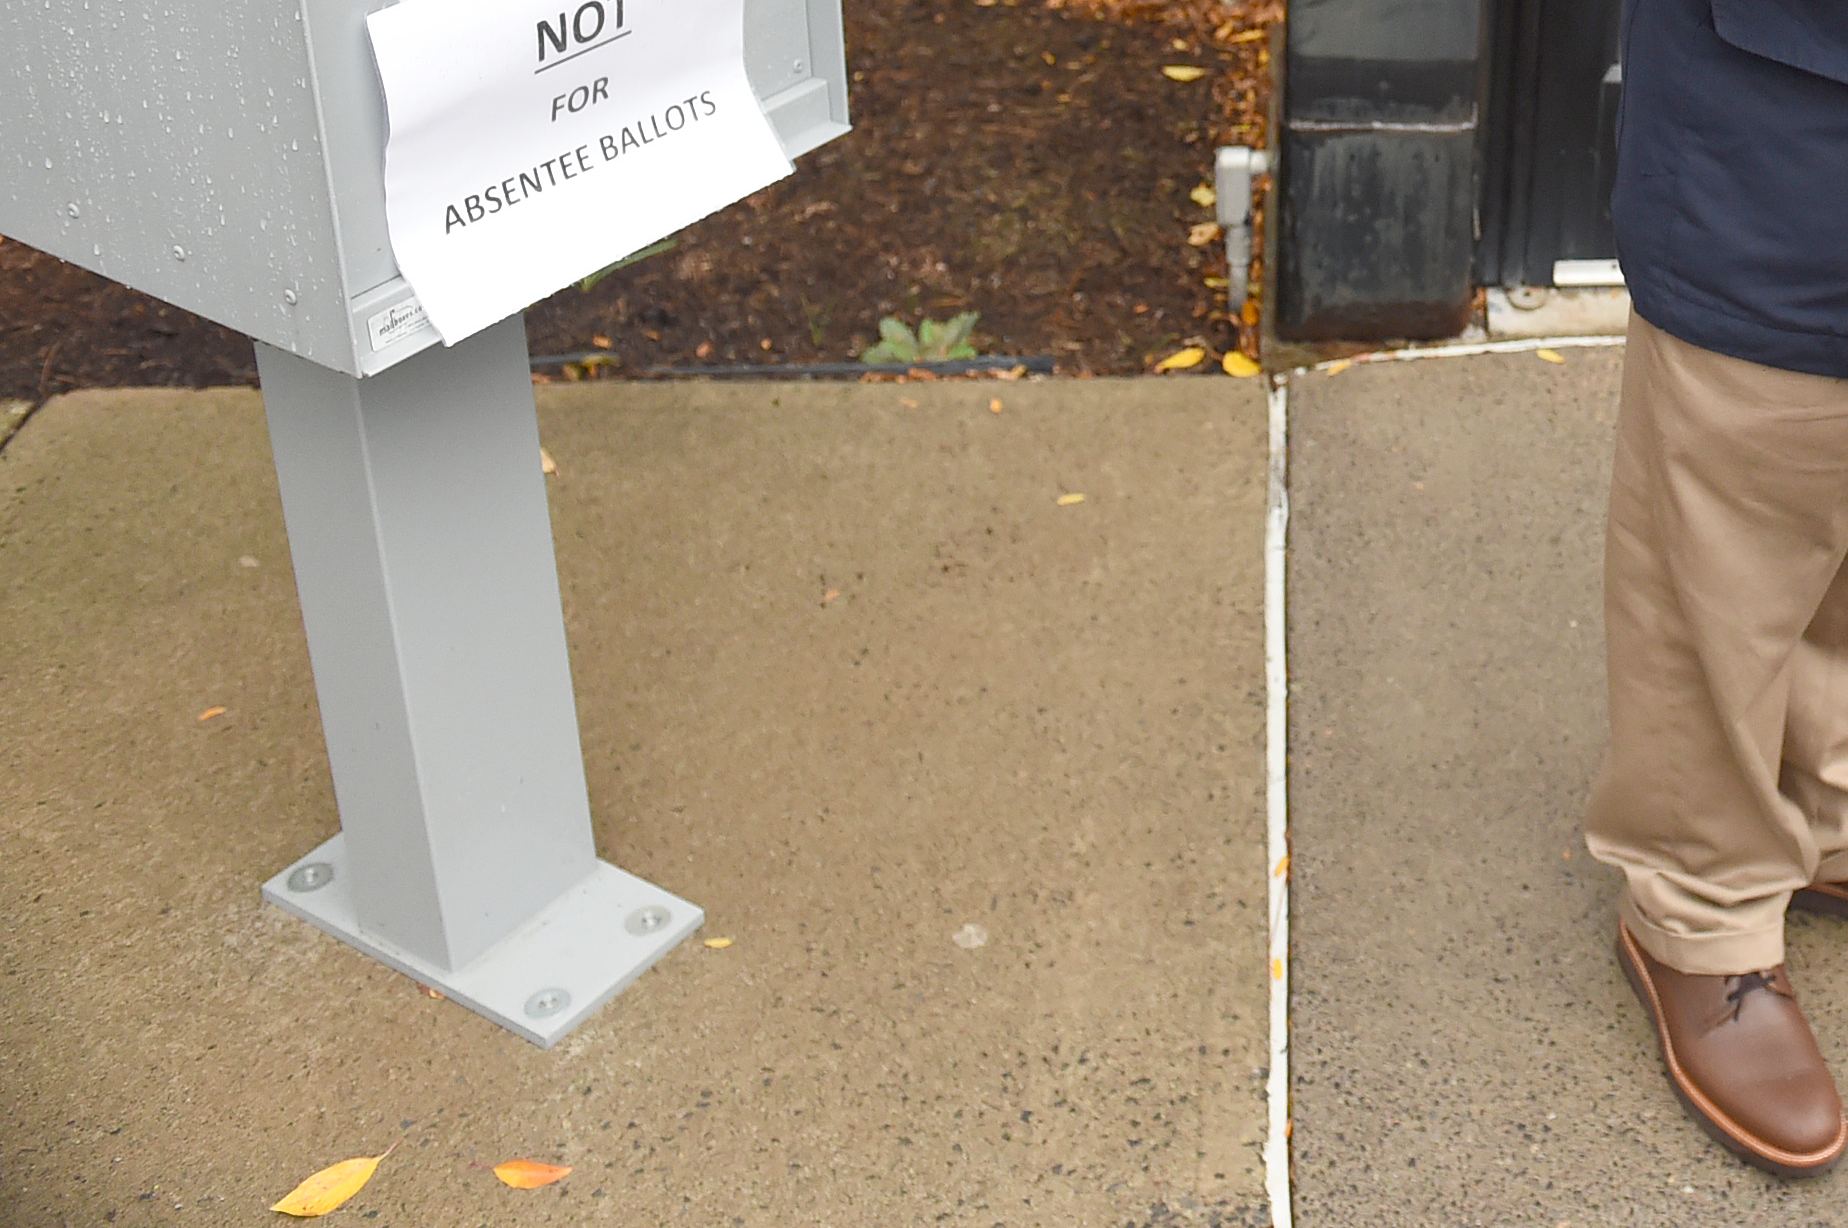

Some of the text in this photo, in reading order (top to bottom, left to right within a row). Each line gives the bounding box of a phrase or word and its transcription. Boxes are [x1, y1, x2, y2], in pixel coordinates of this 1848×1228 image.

[550, 76, 610, 122] FOR
[442, 90, 717, 235] ABSENTEE BALLOTS
[379, 305, 423, 337] mailboxes.co
